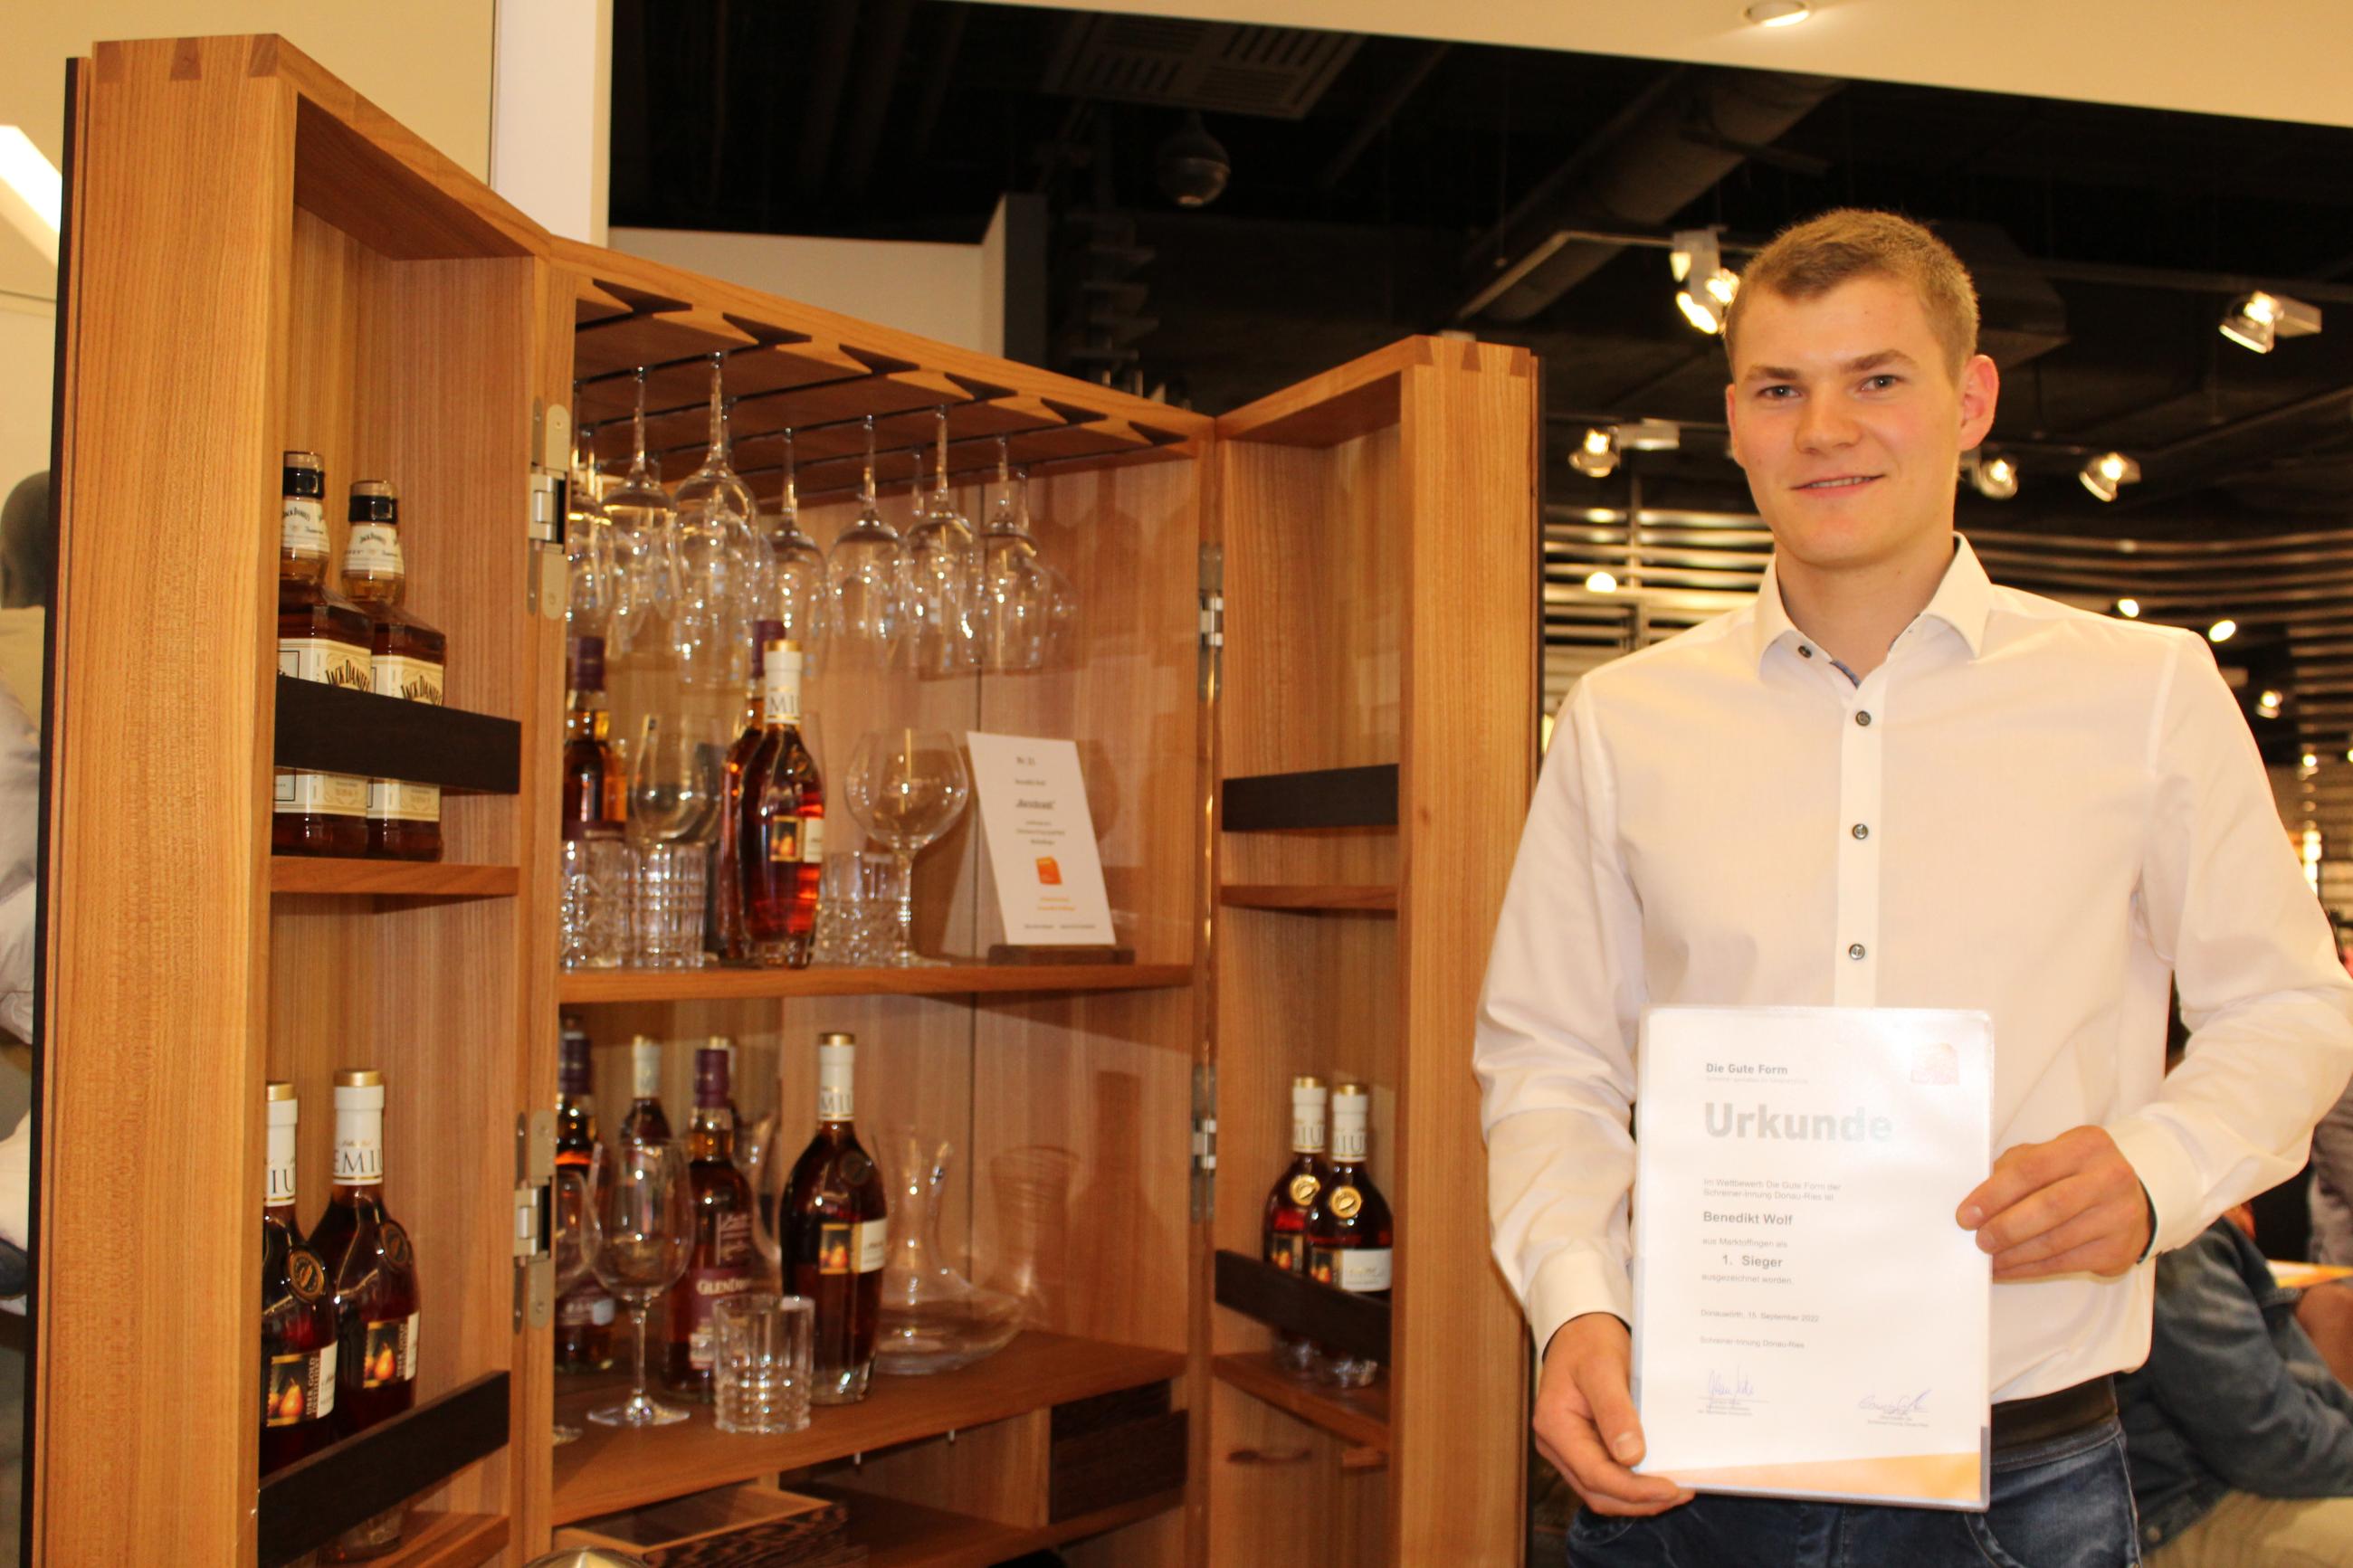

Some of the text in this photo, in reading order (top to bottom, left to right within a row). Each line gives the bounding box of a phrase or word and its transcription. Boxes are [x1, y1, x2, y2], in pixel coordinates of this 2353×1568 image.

[1706, 1062, 1789, 1076] Die Gute Form
[1705, 1101, 1893, 1143] Urkunde
[1703, 1178, 1714, 1186] Im
[1766, 1180, 1780, 1189] Die
[1782, 1181, 1801, 1190] Gute
[1804, 1182, 1825, 1191] Form
[1827, 1183, 1841, 1192] der
[1703, 1211, 1794, 1225] Benedikt Wolf
[1702, 1238, 1717, 1246] aus
[1720, 1237, 1774, 1250] Marktoffingen
[1722, 1254, 1784, 1269] 1. Sieger
[1701, 1273, 1760, 1284] ausgezeichnet
[1761, 1311, 1799, 1323] September
